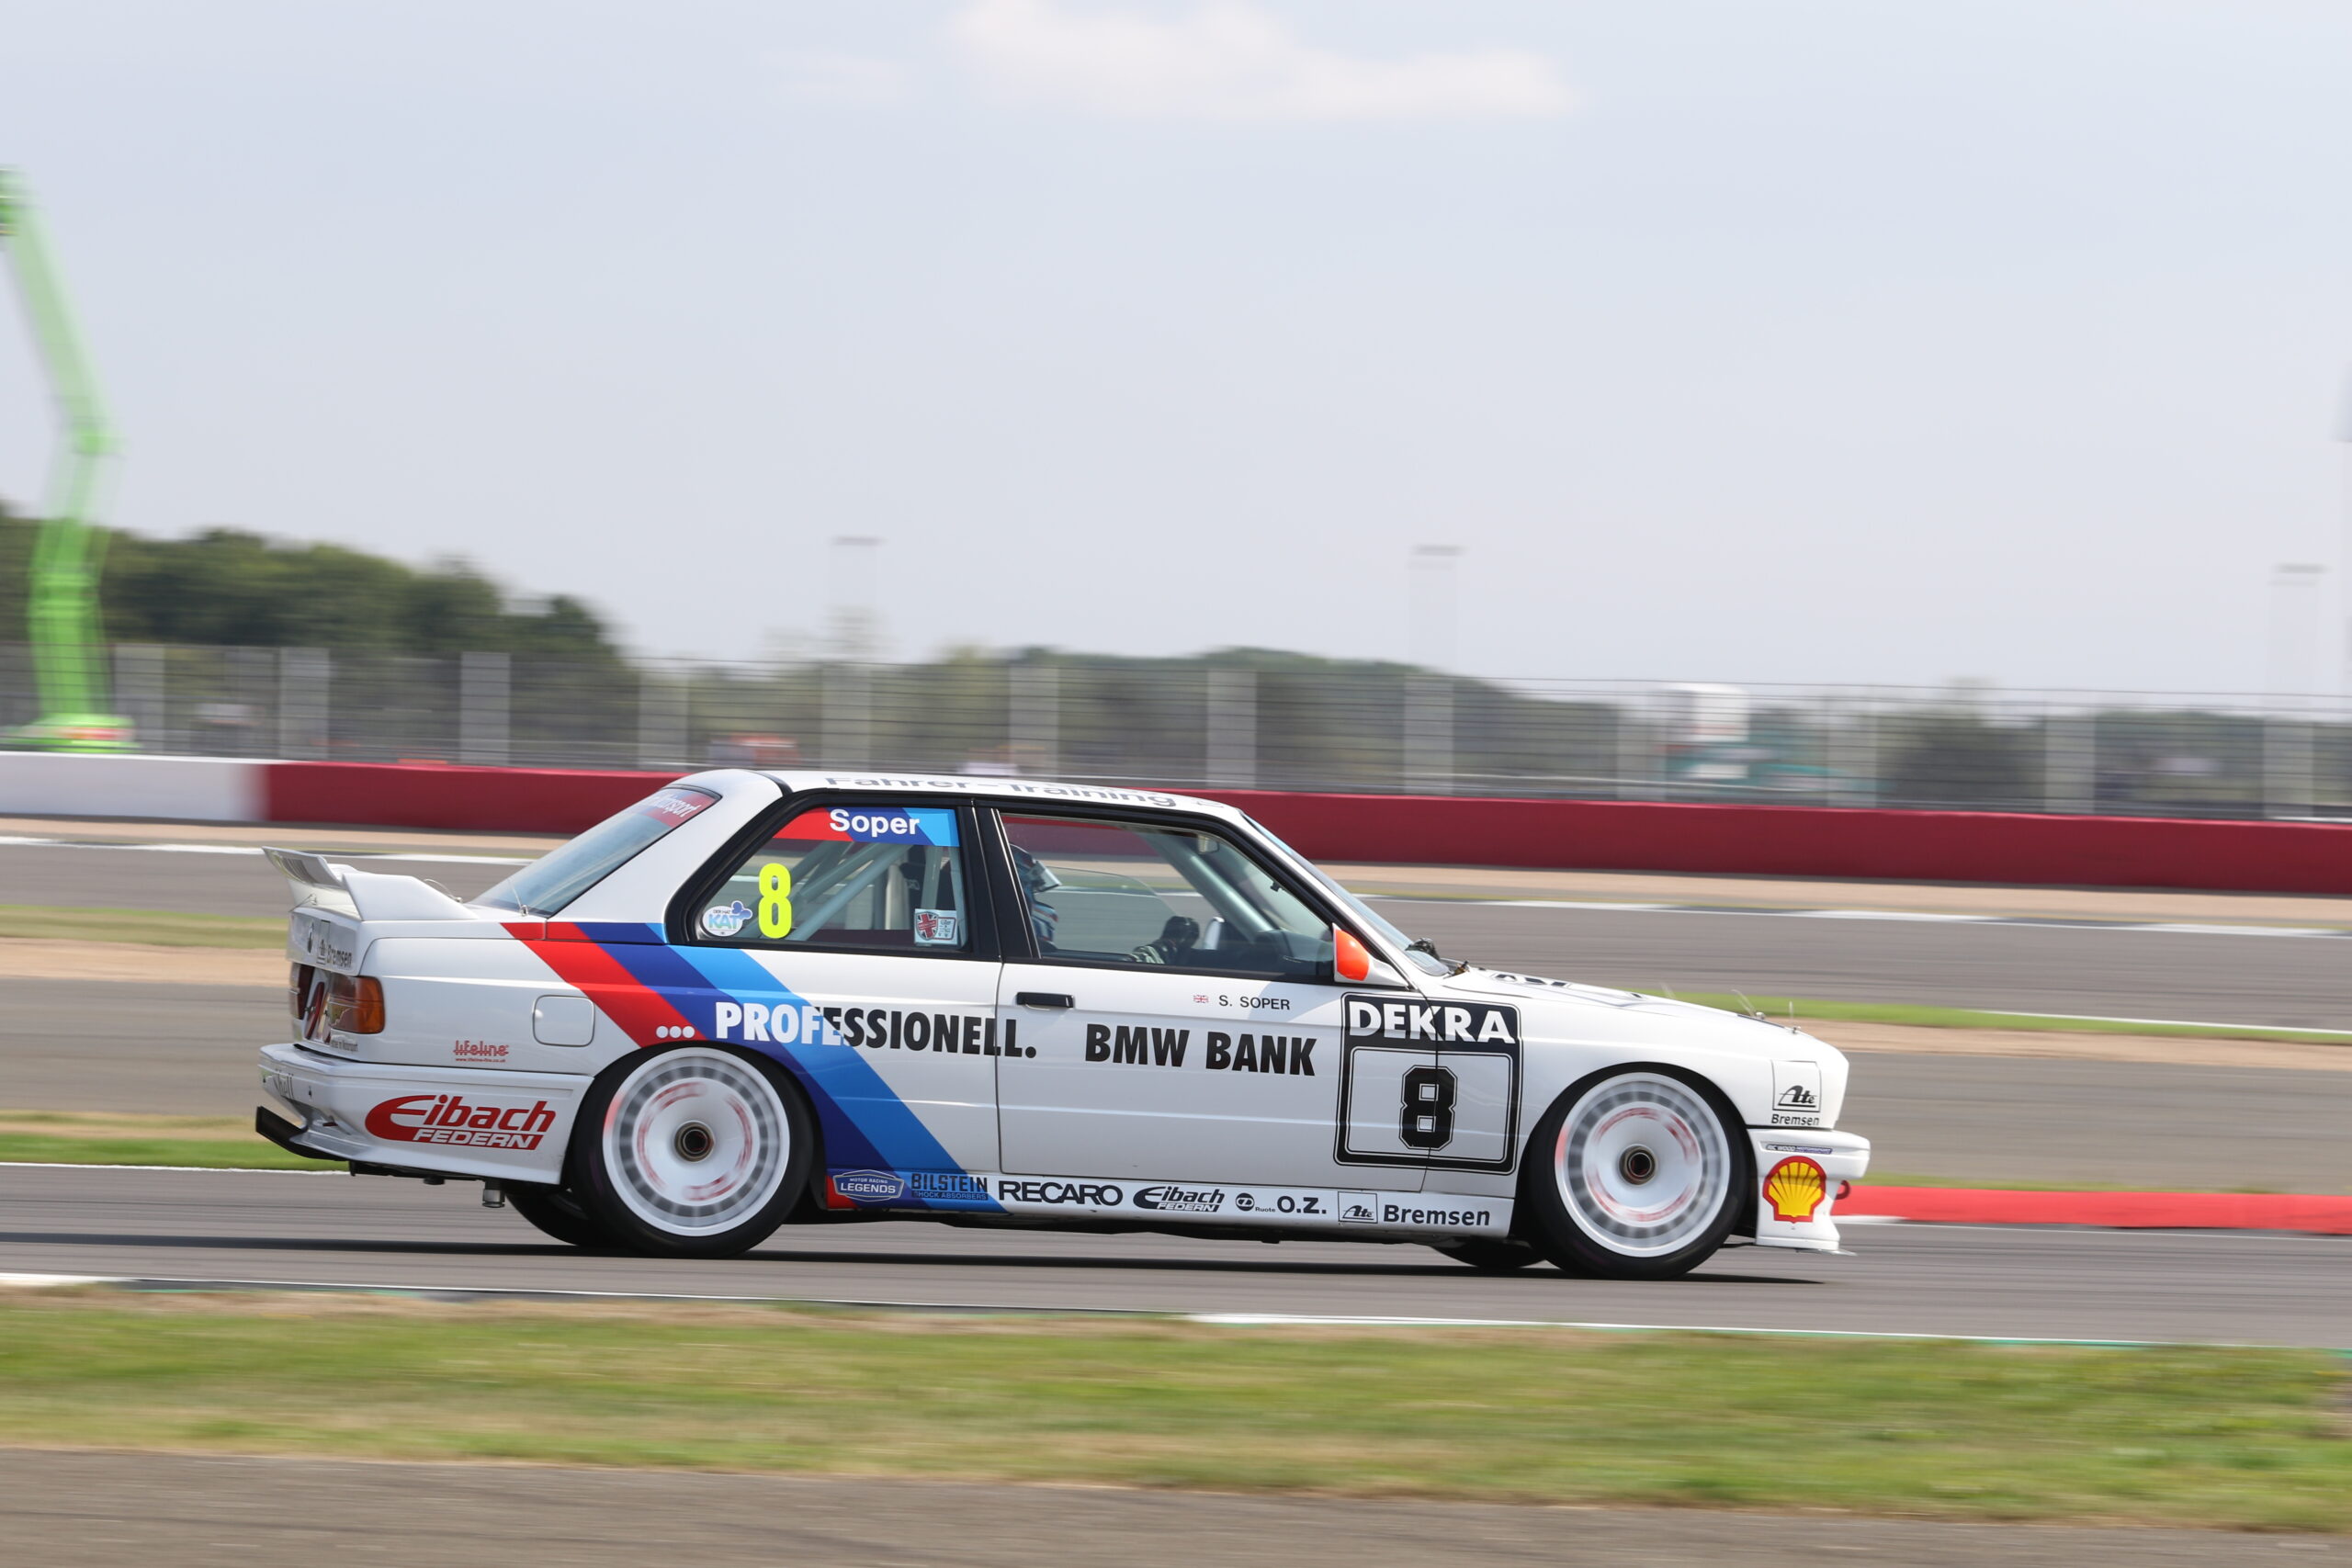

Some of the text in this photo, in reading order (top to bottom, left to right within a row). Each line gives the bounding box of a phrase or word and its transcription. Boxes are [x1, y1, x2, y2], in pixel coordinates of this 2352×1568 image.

[830, 808, 921, 838] Soper
[758, 863, 792, 939] 8
[1218, 995, 1291, 1010] S. SOPER
[1349, 1000, 1516, 1044] DEKRA
[715, 1001, 1037, 1059] PROFESSIONELL.
[1085, 1023, 1191, 1067] BMW
[1205, 1031, 1317, 1077] BANK
[365, 1094, 556, 1135] Eibach
[1399, 1065, 1458, 1152] 8
[1770, 1113, 1820, 1126] Bremsen
[413, 1129, 533, 1148] FEDERN
[841, 1182, 896, 1194] LEGENDS
[911, 1173, 988, 1192] BILSTEIN
[998, 1180, 1124, 1206] RECARO
[941, 1191, 987, 1201] ABSORBERS
[1133, 1186, 1226, 1211] Eibach
[1277, 1195, 1327, 1214] O.Z.
[1156, 1203, 1215, 1213] FEDERN
[1383, 1204, 1490, 1226] Bremsen
